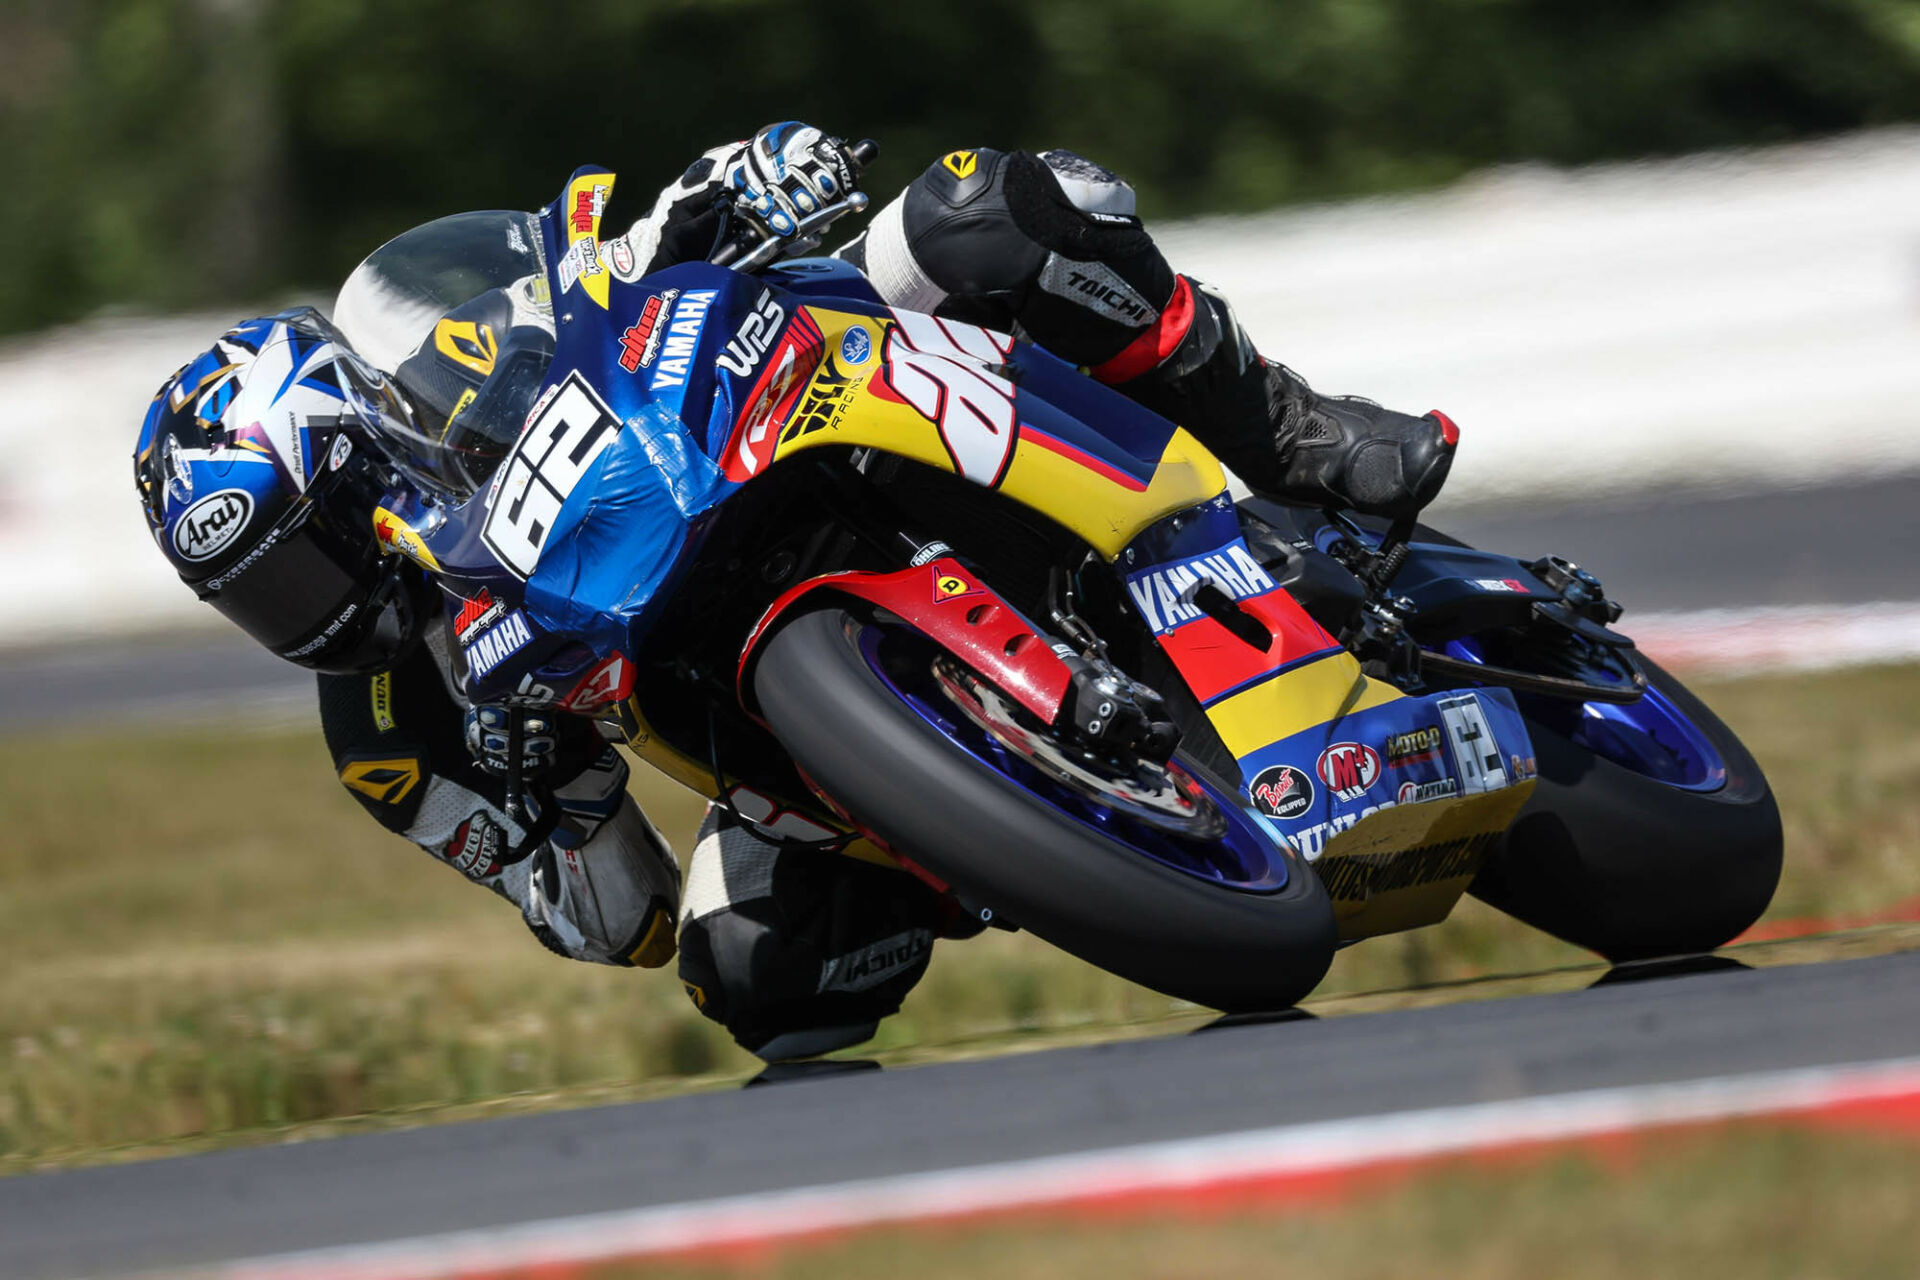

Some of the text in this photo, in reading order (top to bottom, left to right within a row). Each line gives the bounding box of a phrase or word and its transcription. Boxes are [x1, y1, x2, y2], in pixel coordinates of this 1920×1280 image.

[1068, 271, 1147, 321] TAICHI
[652, 292, 716, 389] YAMAHA
[715, 290, 785, 377] WPS
[831, 375, 864, 430] RACING
[486, 382, 618, 574] 62
[185, 495, 239, 556] Arai
[202, 528, 231, 551] HELMET
[1128, 545, 1275, 633] YAMAHA
[1387, 727, 1442, 757] MOTO-D
